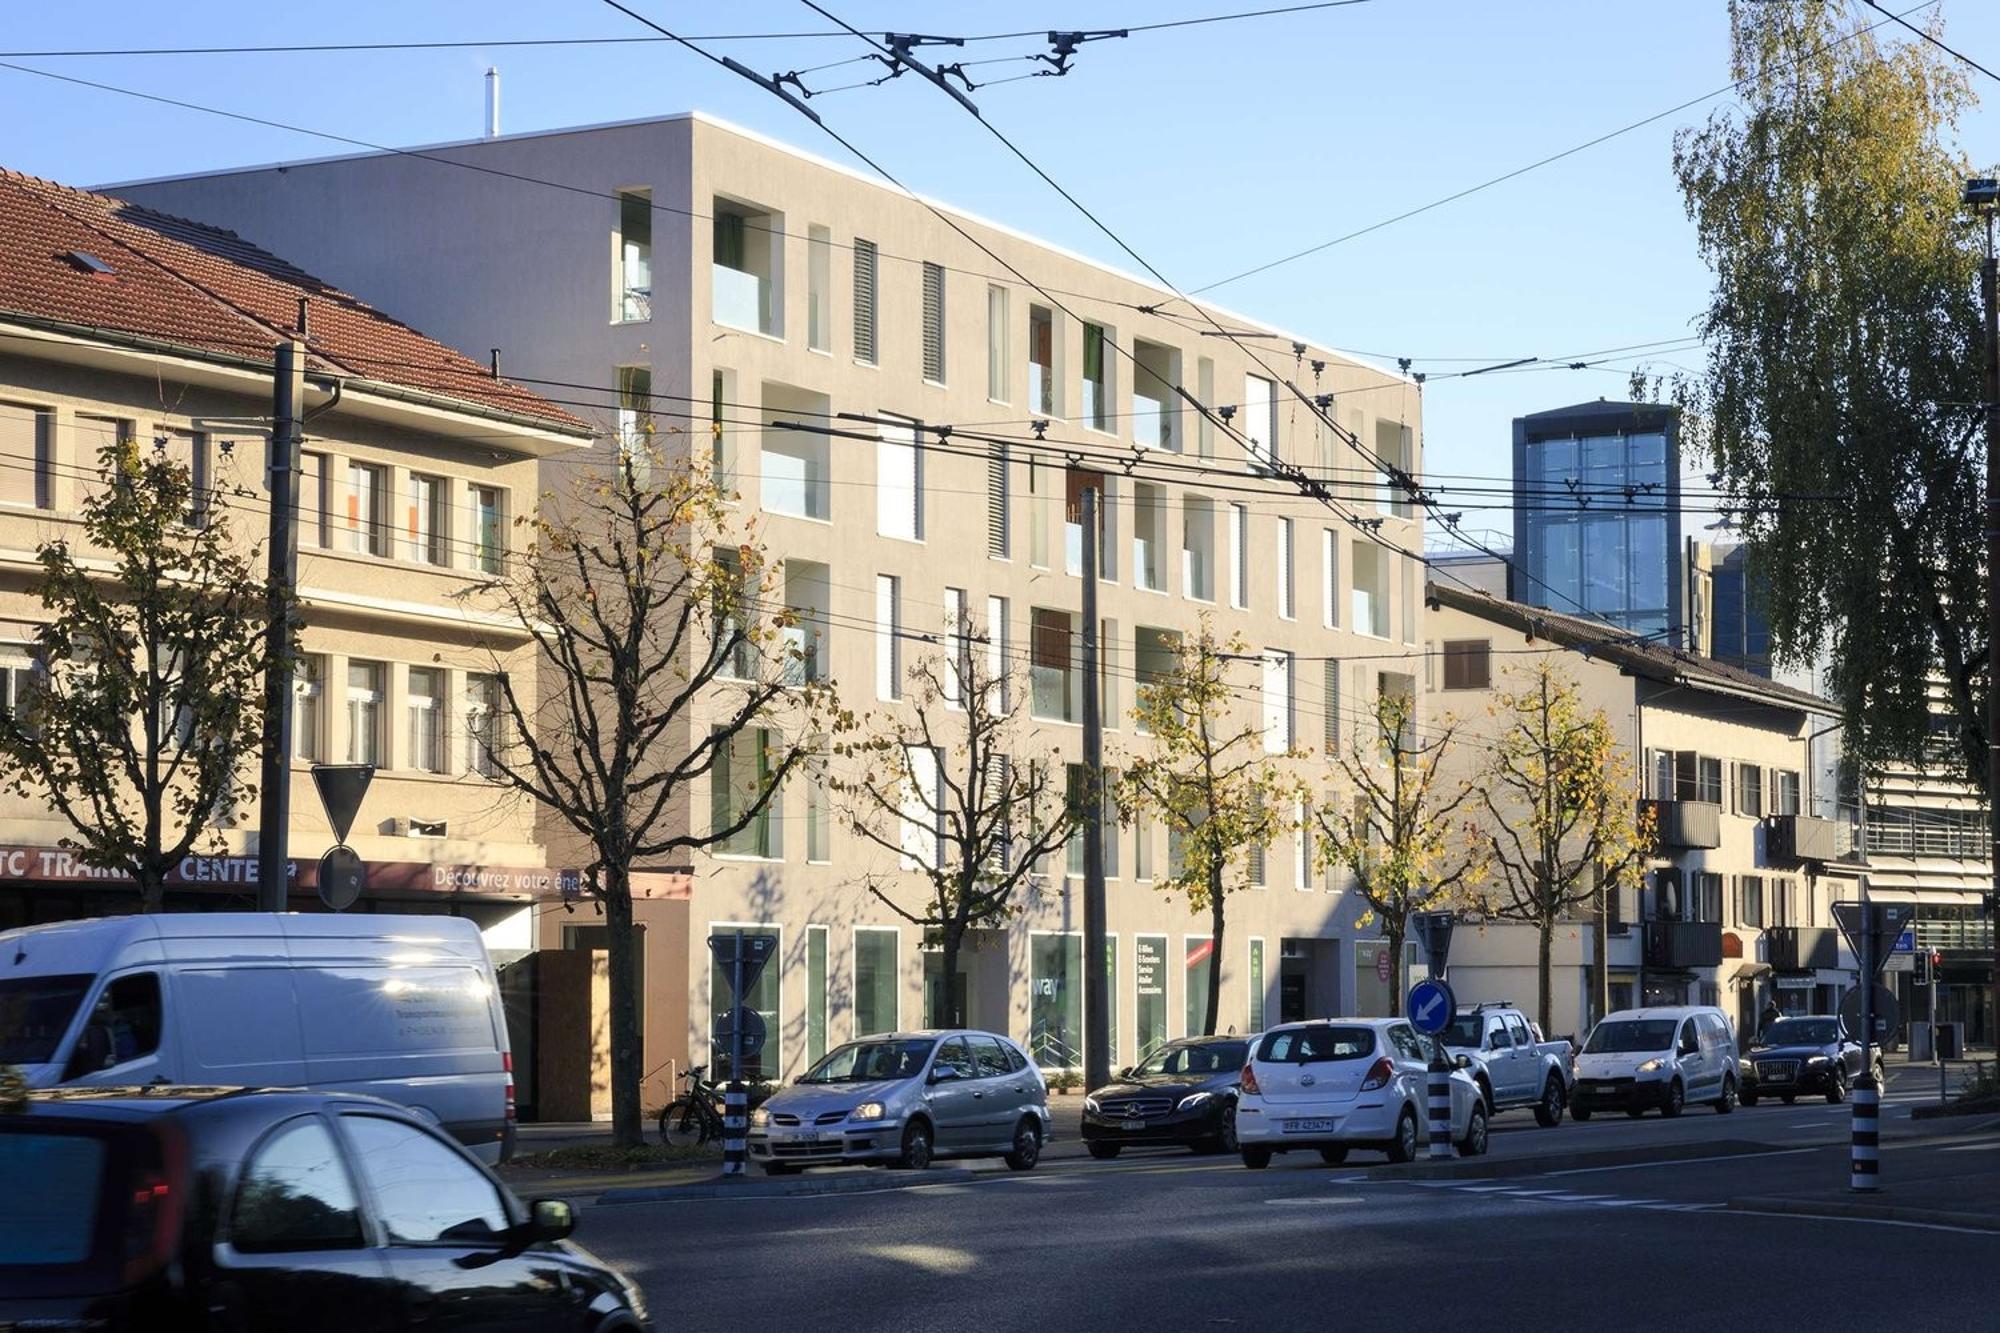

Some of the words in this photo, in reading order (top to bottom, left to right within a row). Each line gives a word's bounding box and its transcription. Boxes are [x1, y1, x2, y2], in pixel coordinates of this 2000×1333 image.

[180, 856, 261, 882] CENTE
[435, 867, 510, 887] Découvrez
[514, 869, 551, 890] votre
[1032, 977, 1058, 1003] way
